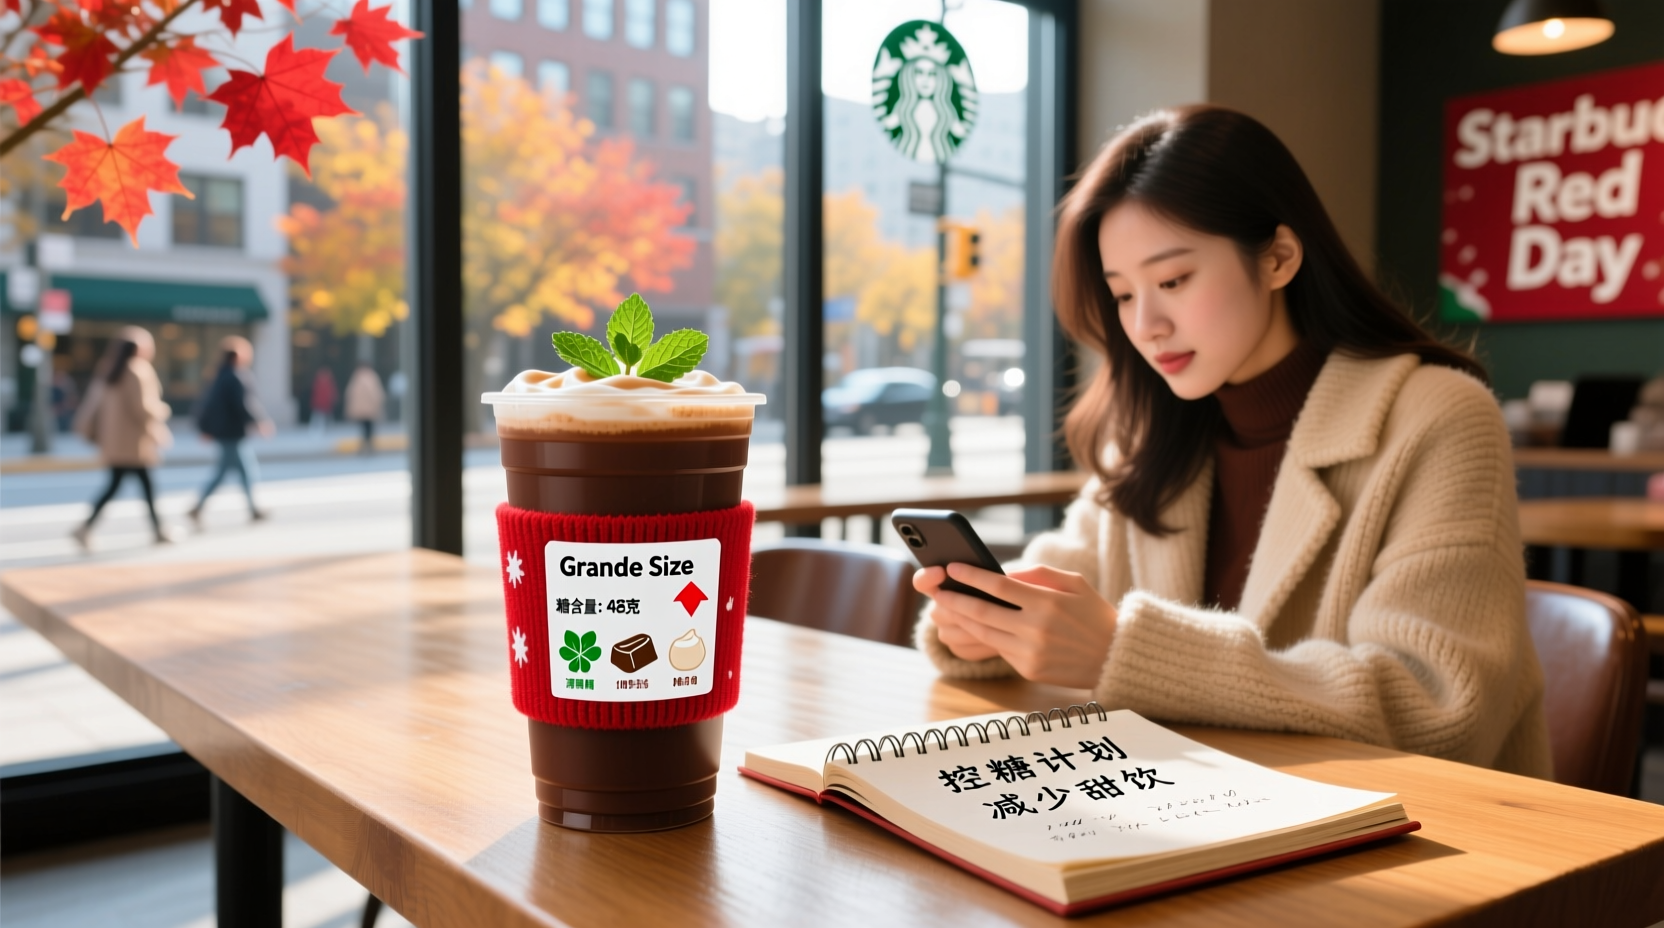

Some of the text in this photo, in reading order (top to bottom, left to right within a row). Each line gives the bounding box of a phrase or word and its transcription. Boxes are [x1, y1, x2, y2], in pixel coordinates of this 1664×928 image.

[1511, 149, 1644, 225] Red
[1506, 225, 1645, 304] Day
[559, 555, 694, 577] Grande Size
[938, 736, 1128, 793] 控糖计划
[982, 766, 1175, 819] 减少甜饮
